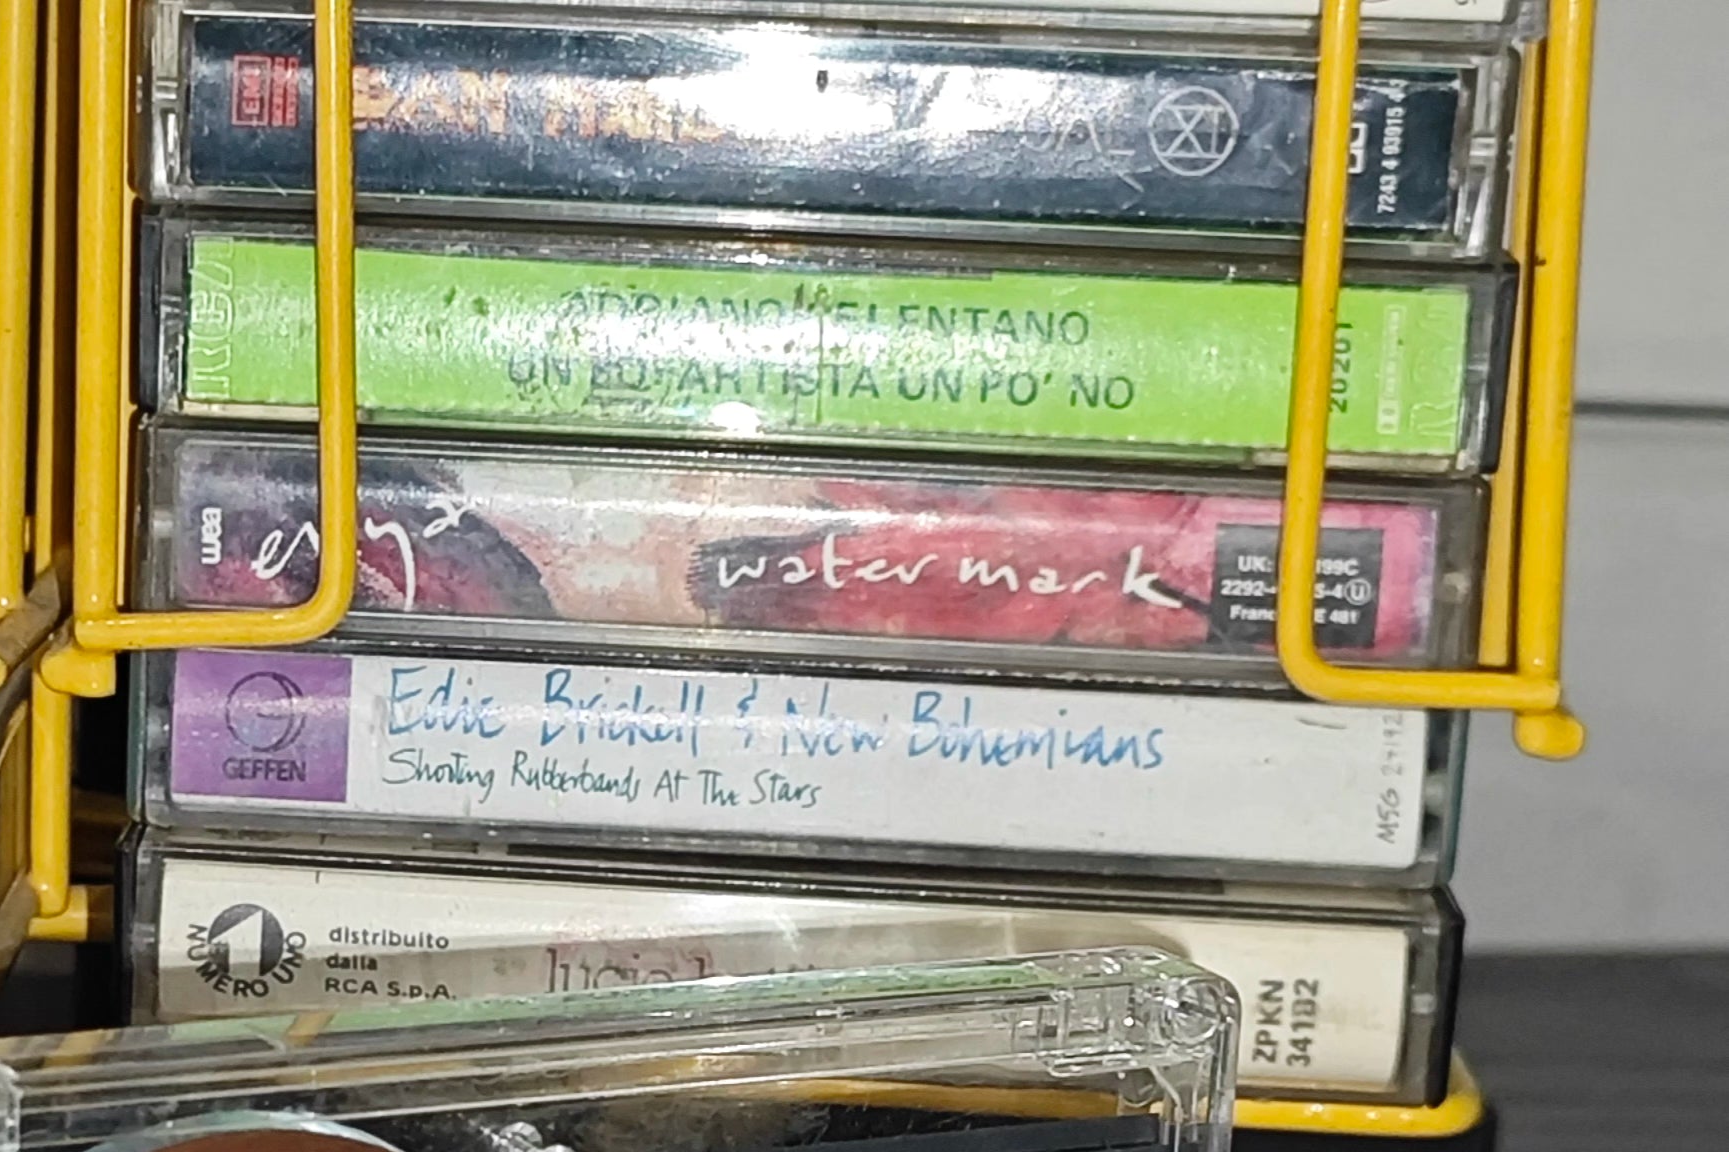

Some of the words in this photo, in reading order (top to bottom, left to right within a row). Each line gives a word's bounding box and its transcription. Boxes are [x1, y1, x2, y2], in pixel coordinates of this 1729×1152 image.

[677, 360, 880, 399] ARTISTA
[898, 366, 962, 402] UN
[980, 371, 1053, 407] PO'
[1070, 374, 1134, 410] NO
[201, 507, 221, 564] wea
[388, 667, 506, 739] Edie
[781, 682, 886, 757] New
[908, 691, 1163, 770] Bohemians
[223, 758, 306, 782] GEFFEN
[382, 748, 494, 804] Shooting
[511, 751, 641, 801] Rubberbands
[654, 769, 688, 801] At
[699, 769, 741, 807] The
[750, 769, 822, 808] Stars
[187, 923, 270, 998] NUMERO
[271, 931, 307, 985] UNO
[325, 952, 378, 971] dalla
[329, 926, 450, 949] distribuito
[324, 977, 378, 995] RCA
[387, 981, 457, 1000] S.p.A.
[1252, 980, 1284, 1063] ZPKN
